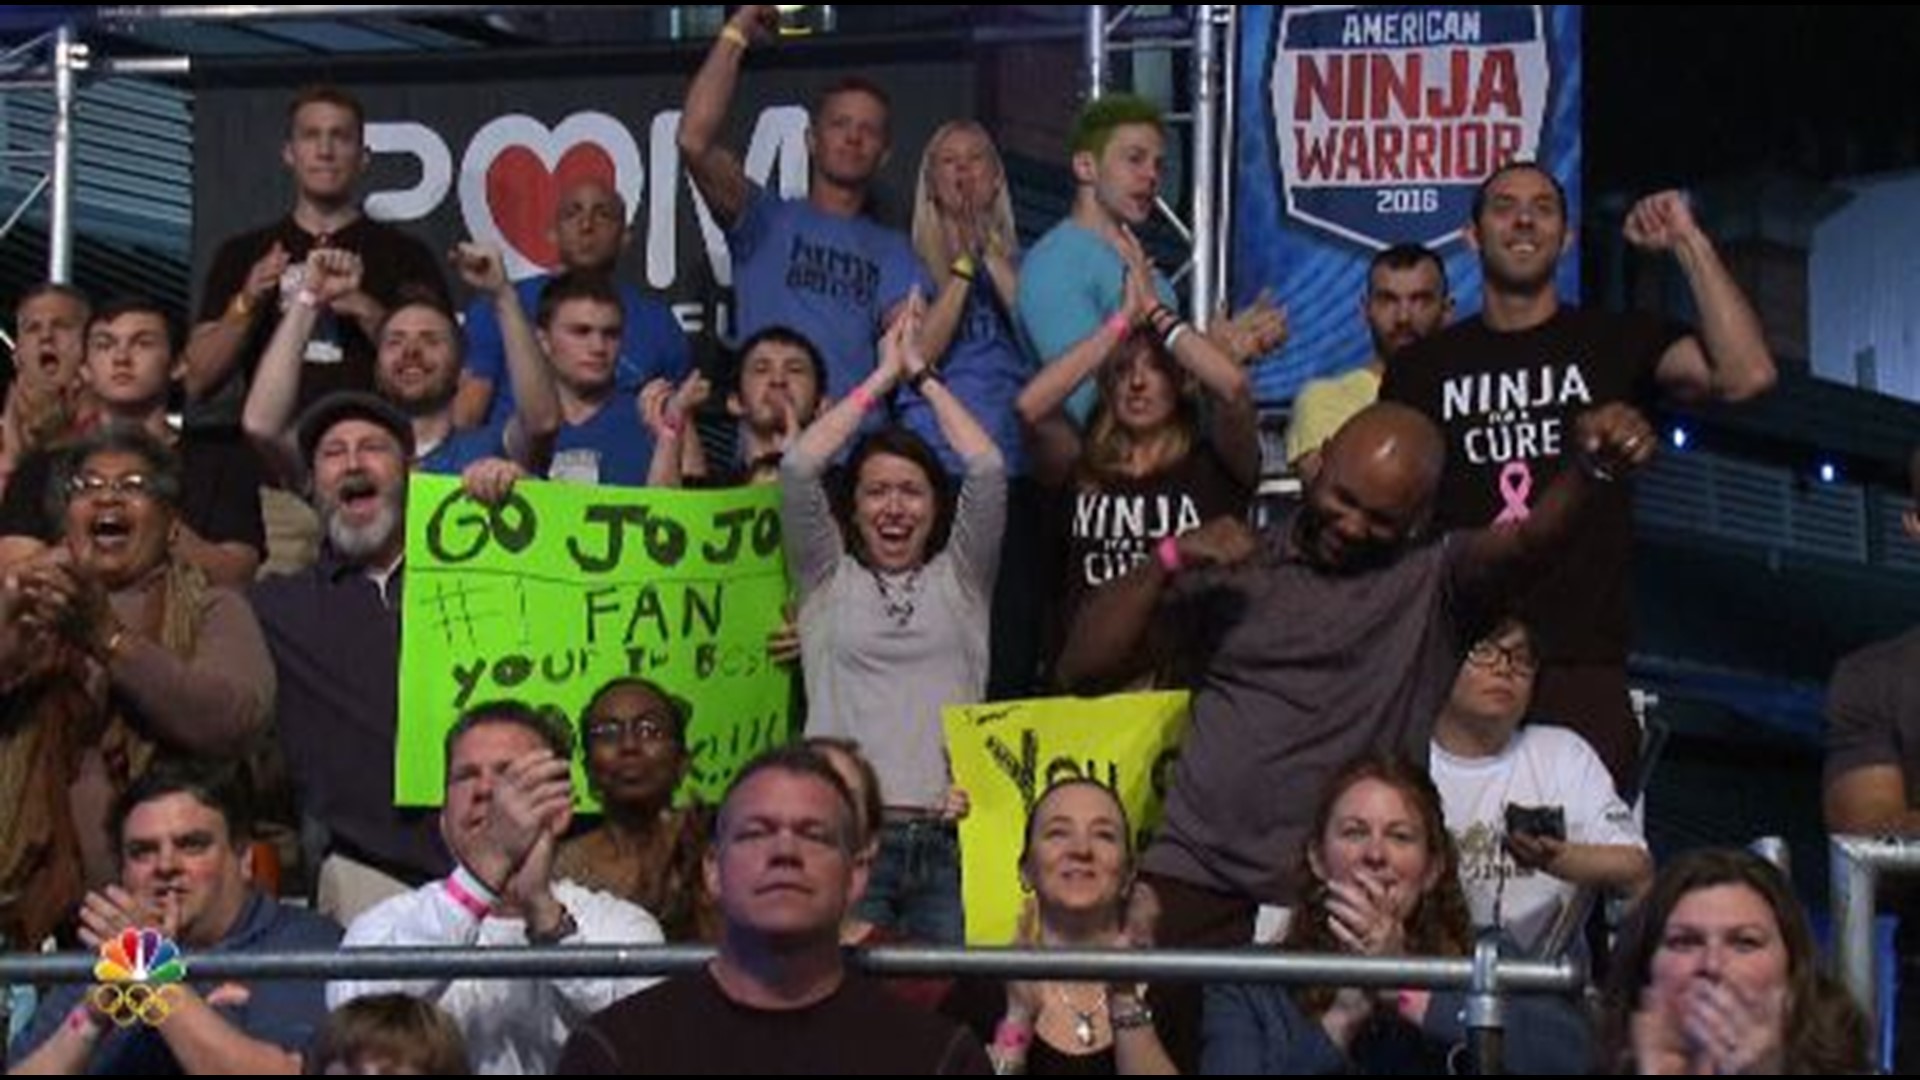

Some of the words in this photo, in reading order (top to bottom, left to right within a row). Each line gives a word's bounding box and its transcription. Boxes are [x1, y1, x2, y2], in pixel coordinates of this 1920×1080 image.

[1342, 11, 1481, 45] AMERICAN
[1293, 49, 1522, 120] NINJA
[1293, 122, 1522, 181] WARRIOR
[1376, 189, 1439, 213] 2016
[1443, 363, 1592, 421] NINJA
[1463, 418, 1562, 465] CURE
[427, 488, 538, 563] GO
[566, 504, 687, 573] JO
[702, 507, 782, 564] JO
[584, 580, 725, 645] FAN
